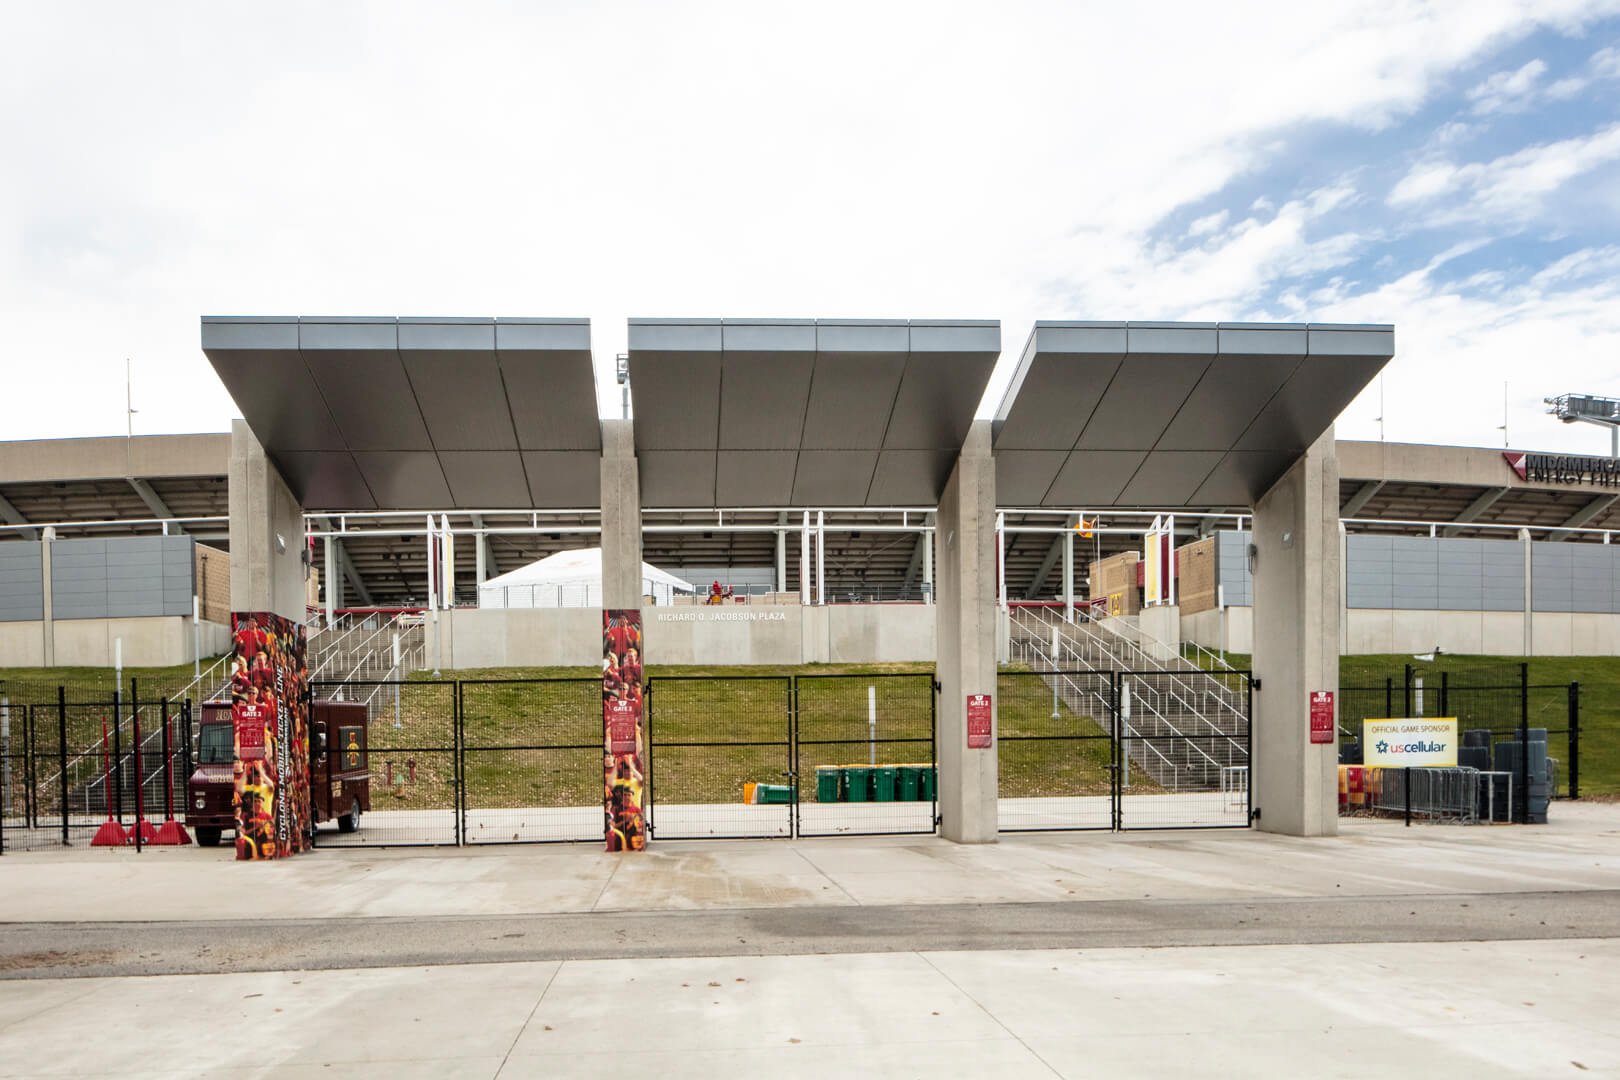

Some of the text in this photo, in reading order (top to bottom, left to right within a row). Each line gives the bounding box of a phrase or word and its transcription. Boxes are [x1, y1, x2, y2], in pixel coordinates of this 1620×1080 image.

[658, 613, 695, 622] RICHARD
[711, 612, 756, 621] JACOBSON
[759, 611, 785, 621] PLAZA
[1371, 724, 1451, 734] OFFICIAL GAME SPONSOR
